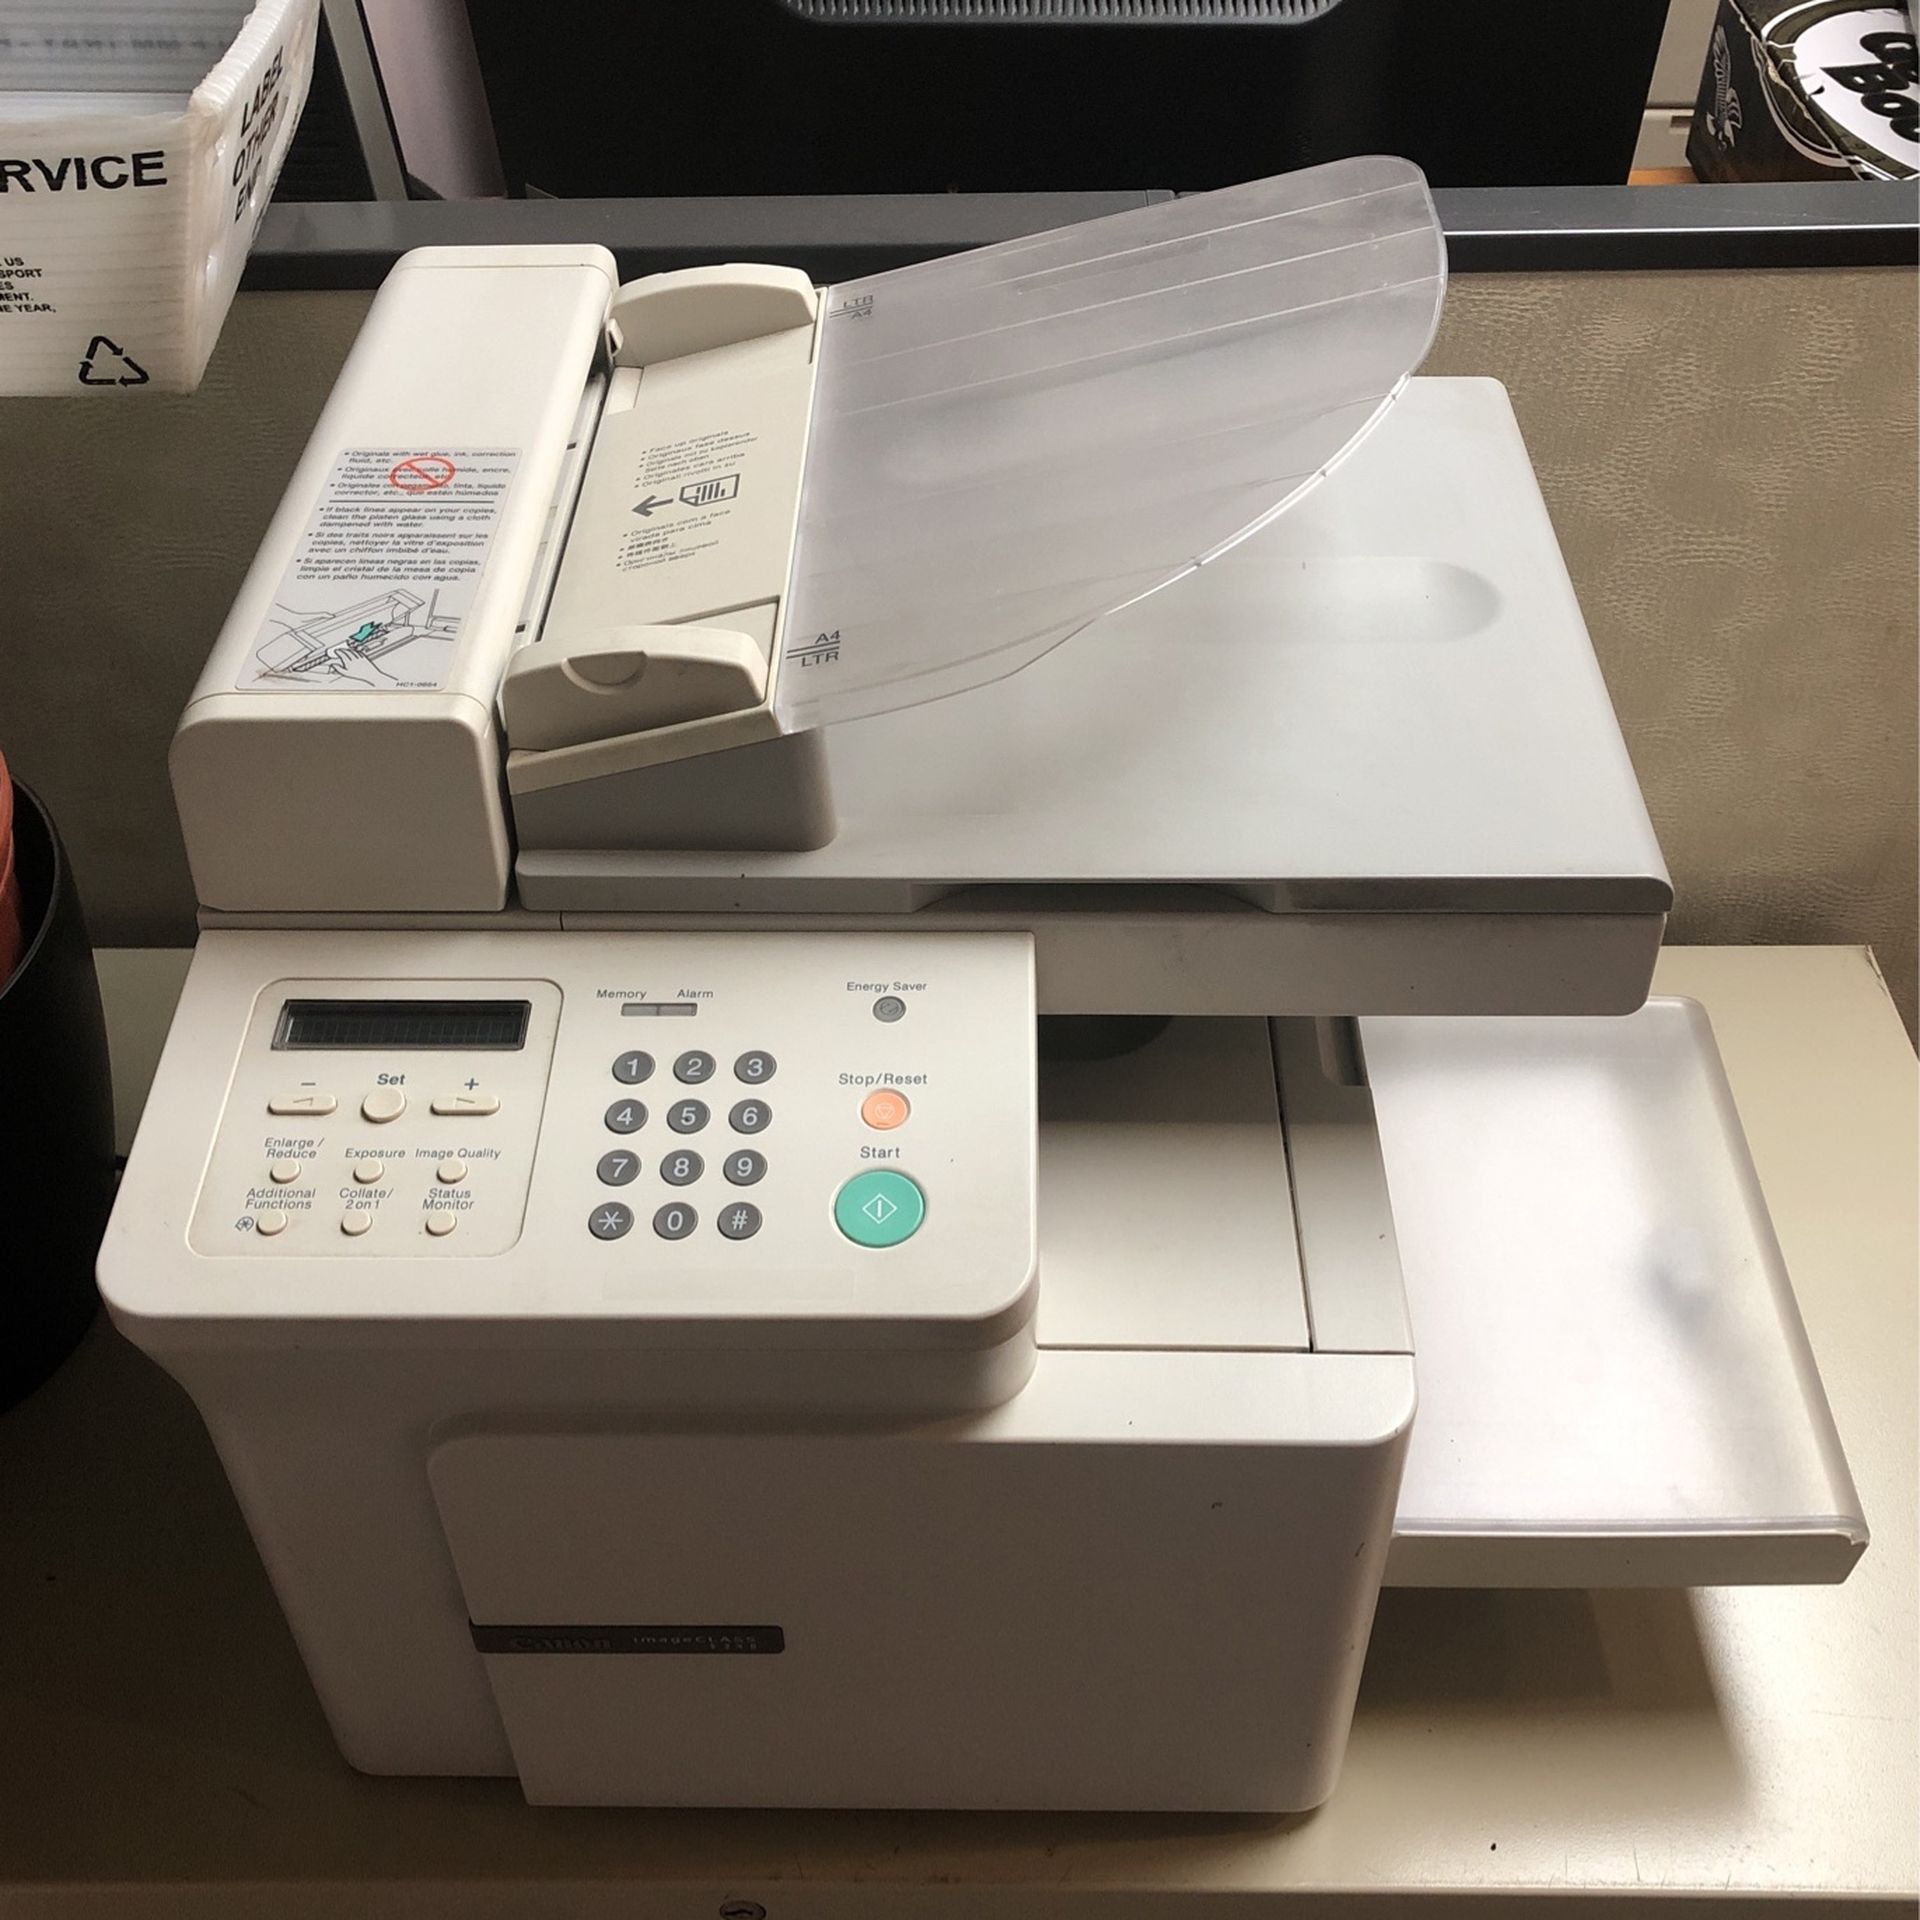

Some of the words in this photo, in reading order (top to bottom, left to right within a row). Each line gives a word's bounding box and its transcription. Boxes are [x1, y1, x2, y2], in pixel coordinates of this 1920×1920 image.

[240, 44, 284, 138] LABEL
[0, 150, 168, 193] RVICE
[4, 257, 25, 267] US
[0, 268, 42, 279] SPORT
[14, 303, 57, 313] YEAR,
[815, 630, 840, 644] A4
[801, 652, 840, 668] LTR
[677, 988, 714, 999] Alarm
[846, 980, 889, 993] Energy
[893, 981, 927, 992] Saver
[597, 988, 647, 1001] Memory
[627, 1058, 640, 1076] 1
[687, 1058, 703, 1076] 2
[747, 1058, 763, 1076] 3
[376, 1073, 406, 1086] Set
[838, 1071, 928, 1087] Stop/Reset
[616, 1107, 634, 1125] 4
[681, 1107, 696, 1125] 5
[743, 1107, 758, 1125] 6
[266, 1149, 317, 1159] Reduce
[345, 1148, 406, 1161] Exposure
[415, 1148, 454, 1161] Image
[457, 1148, 501, 1161] Quality
[859, 1146, 901, 1160] Start
[611, 1159, 629, 1178] 7
[673, 1159, 690, 1178] 8
[736, 1159, 753, 1177] 9
[246, 1188, 316, 1199] Additional
[339, 1187, 394, 1199] Collate/
[428, 1188, 471, 1199] Status
[245, 1199, 312, 1210] Functions
[422, 1199, 474, 1210] Monitor
[666, 1211, 684, 1231] 0
[731, 1210, 749, 1231] #
